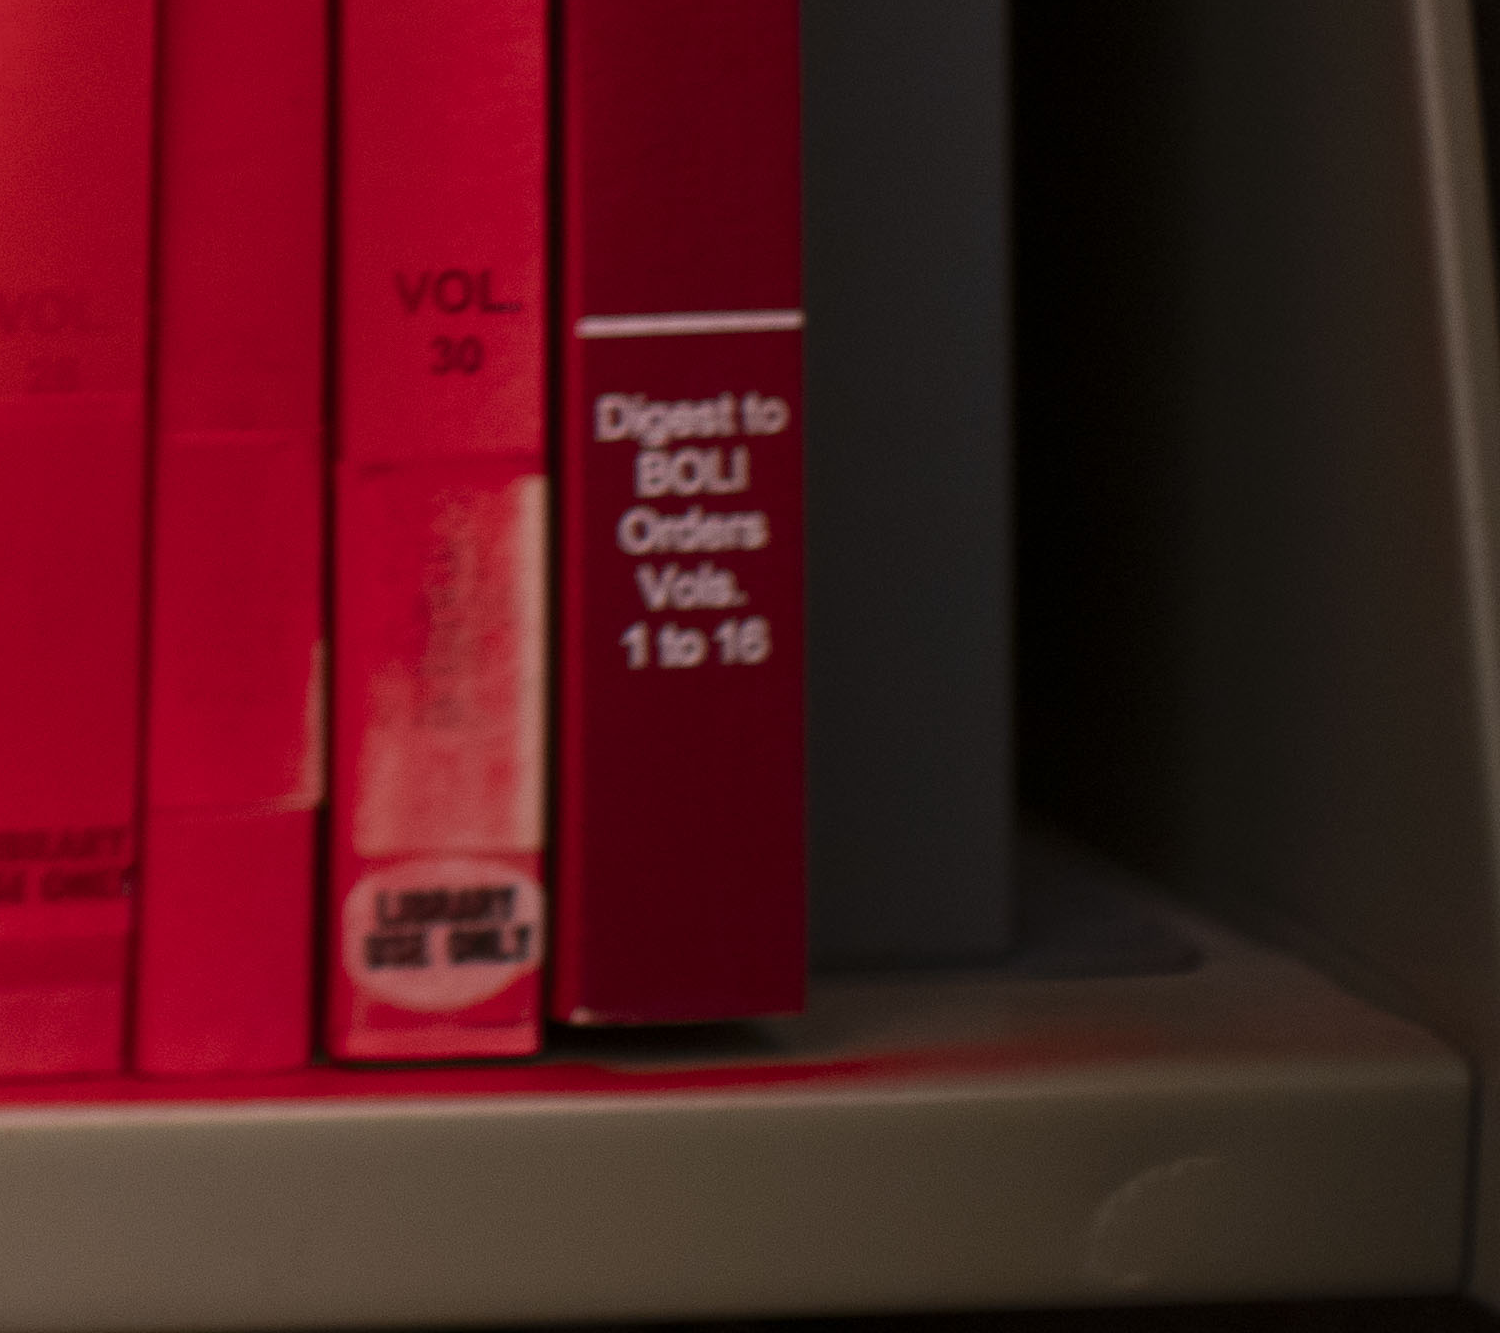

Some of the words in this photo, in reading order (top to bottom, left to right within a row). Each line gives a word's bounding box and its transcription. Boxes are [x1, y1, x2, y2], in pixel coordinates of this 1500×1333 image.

[430, 337, 484, 376] 30
[593, 392, 738, 447] Digest
[742, 391, 790, 434] to
[635, 445, 750, 497] BOLI
[616, 504, 770, 556] Orders
[635, 561, 749, 612] Vols.
[619, 621, 649, 670] 1
[657, 621, 709, 668] to
[375, 886, 518, 925] LIBRARY
